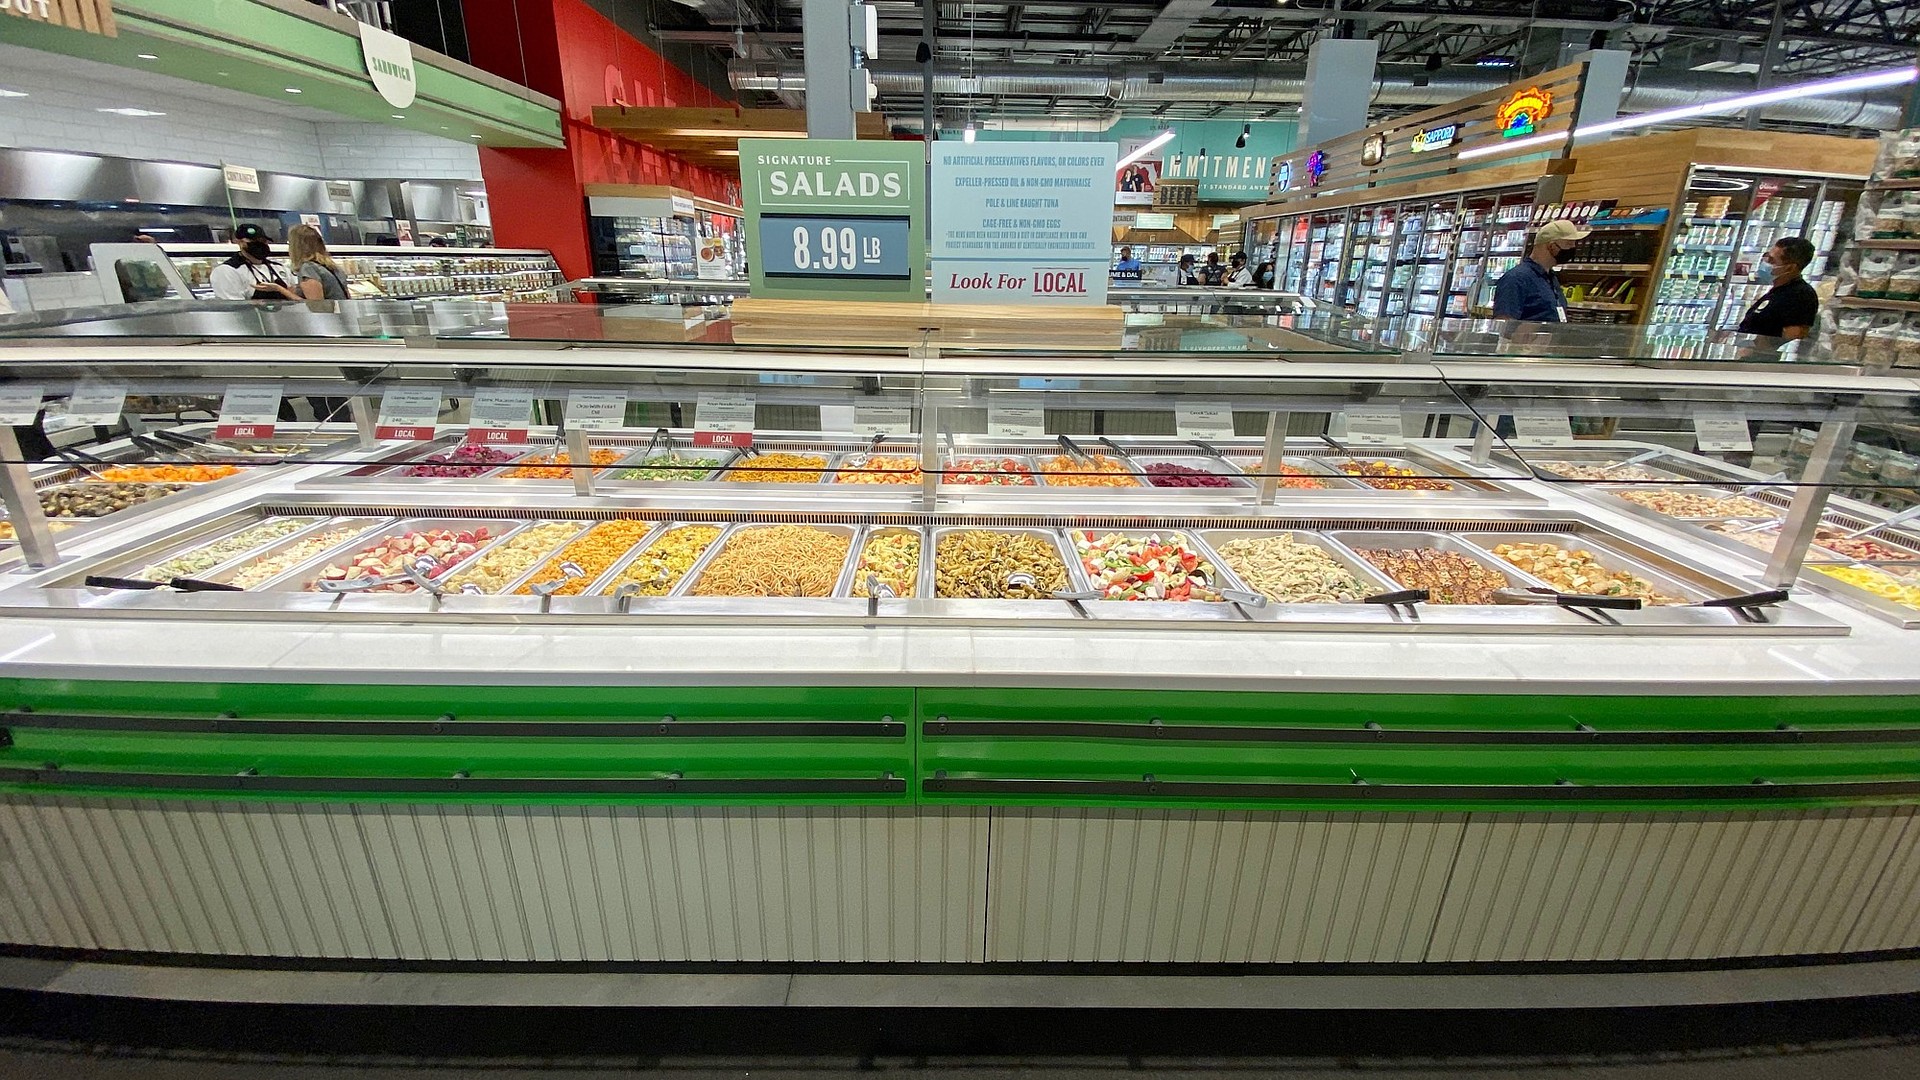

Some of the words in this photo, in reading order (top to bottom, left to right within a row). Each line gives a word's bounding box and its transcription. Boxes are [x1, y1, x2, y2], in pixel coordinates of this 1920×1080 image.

[372, 56, 411, 81] SANDWICH
[1426, 126, 1455, 143] SAPPORO
[758, 155, 832, 165] SIGNATURE
[943, 155, 951, 165] NO
[953, 156, 984, 165] ARTIFICIAL
[984, 156, 1030, 166] PRESERVATIVES
[1030, 157, 1057, 168] FLAVORS,
[1058, 157, 1066, 166] OR
[1067, 157, 1090, 166] COLORS
[1090, 157, 1105, 166] EVER
[770, 171, 901, 198] SALADS
[955, 177, 1009, 187] EXPELLER-PRESSED
[1010, 177, 1019, 187] OIL
[1020, 178, 1025, 187] &
[1026, 178, 1053, 187] NON-GMO
[1054, 178, 1092, 187] MAYONNAISE
[1161, 187, 1192, 204] BEER
[985, 198, 999, 208] POLE
[1000, 199, 1005, 208] &
[1006, 199, 1019, 208] LINE
[1044, 199, 1059, 208] TUNA
[982, 219, 1012, 228] CAGE-FREE
[1013, 219, 1018, 228] &
[1019, 219, 1046, 228] NON-GMO
[1046, 219, 1062, 228] EGGS
[793, 226, 857, 270] 8.99
[863, 237, 881, 259] LB
[951, 272, 993, 289] Look
[997, 273, 1026, 289] For
[1033, 272, 1087, 292] LOCAL
[234, 427, 255, 436] LOCAL
[394, 429, 416, 438] LOCAL
[487, 432, 508, 440] LOCAL
[712, 435, 733, 443] LOCAL
